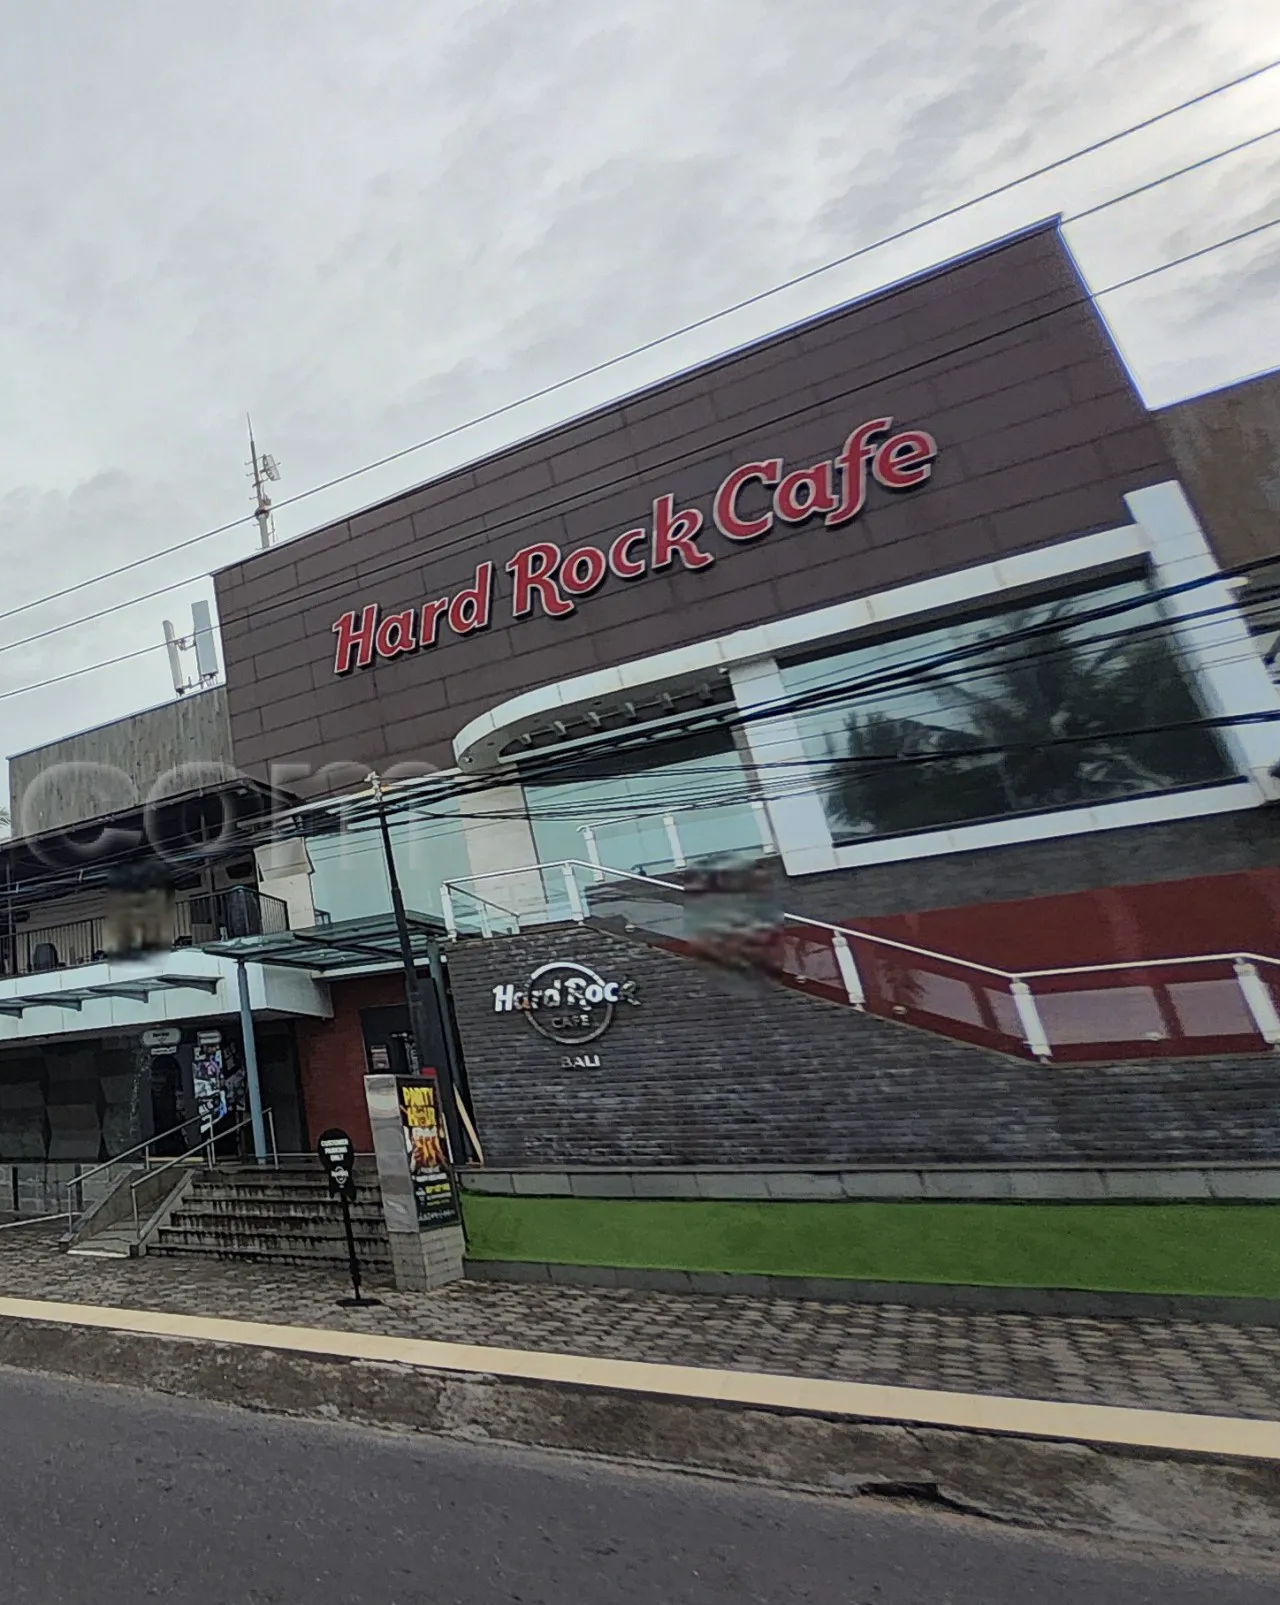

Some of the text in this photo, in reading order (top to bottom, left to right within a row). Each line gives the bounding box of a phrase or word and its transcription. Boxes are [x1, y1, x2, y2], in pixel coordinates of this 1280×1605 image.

[331, 416, 939, 676] Hard Rock Cafe
[492, 979, 562, 1012] Hard
[551, 1014, 591, 1028] CAFE
[560, 1054, 601, 1069] BALI
[402, 1087, 434, 1106] PARTY
